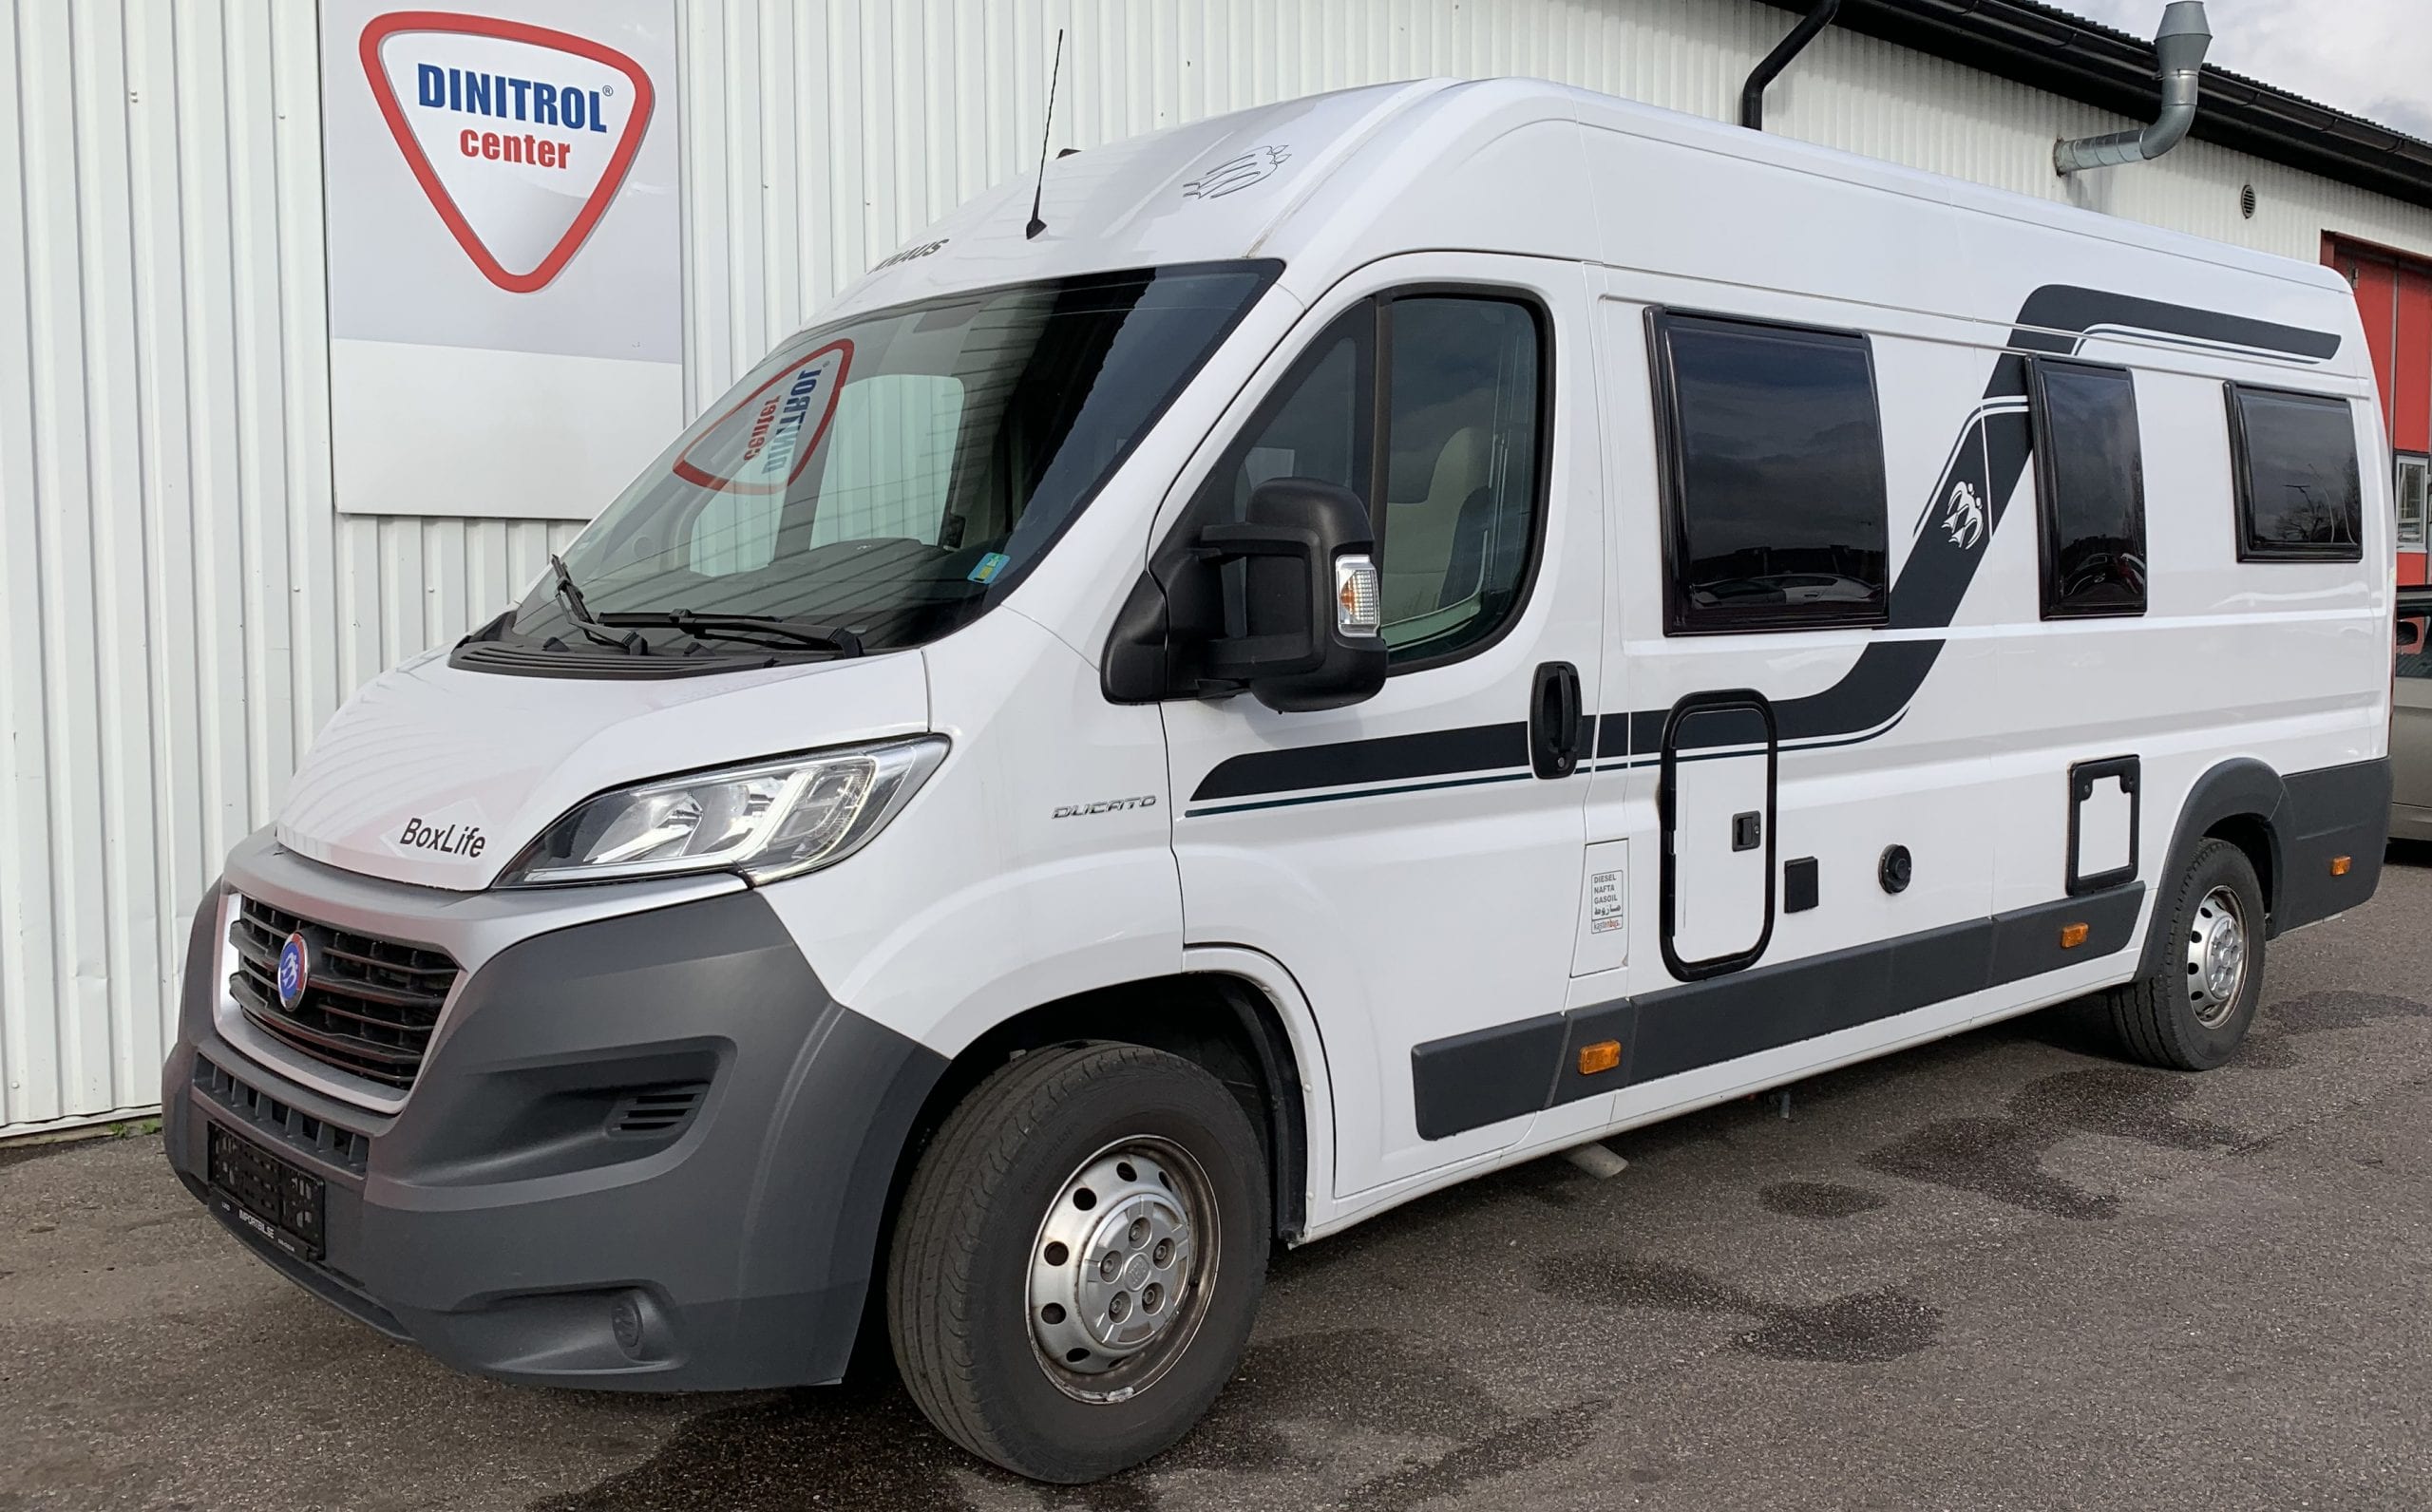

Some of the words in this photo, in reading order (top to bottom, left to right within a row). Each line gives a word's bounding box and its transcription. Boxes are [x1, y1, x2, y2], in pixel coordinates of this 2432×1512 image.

[417, 63, 608, 133] DINITROL
[460, 129, 571, 170] center
[1052, 795, 1157, 819] DUCATO
[399, 817, 486, 859] BoxLife
[1593, 873, 1617, 884] DIESEL
[1593, 884, 1615, 894] NAFTA
[1593, 895, 1618, 904] GASOIL
